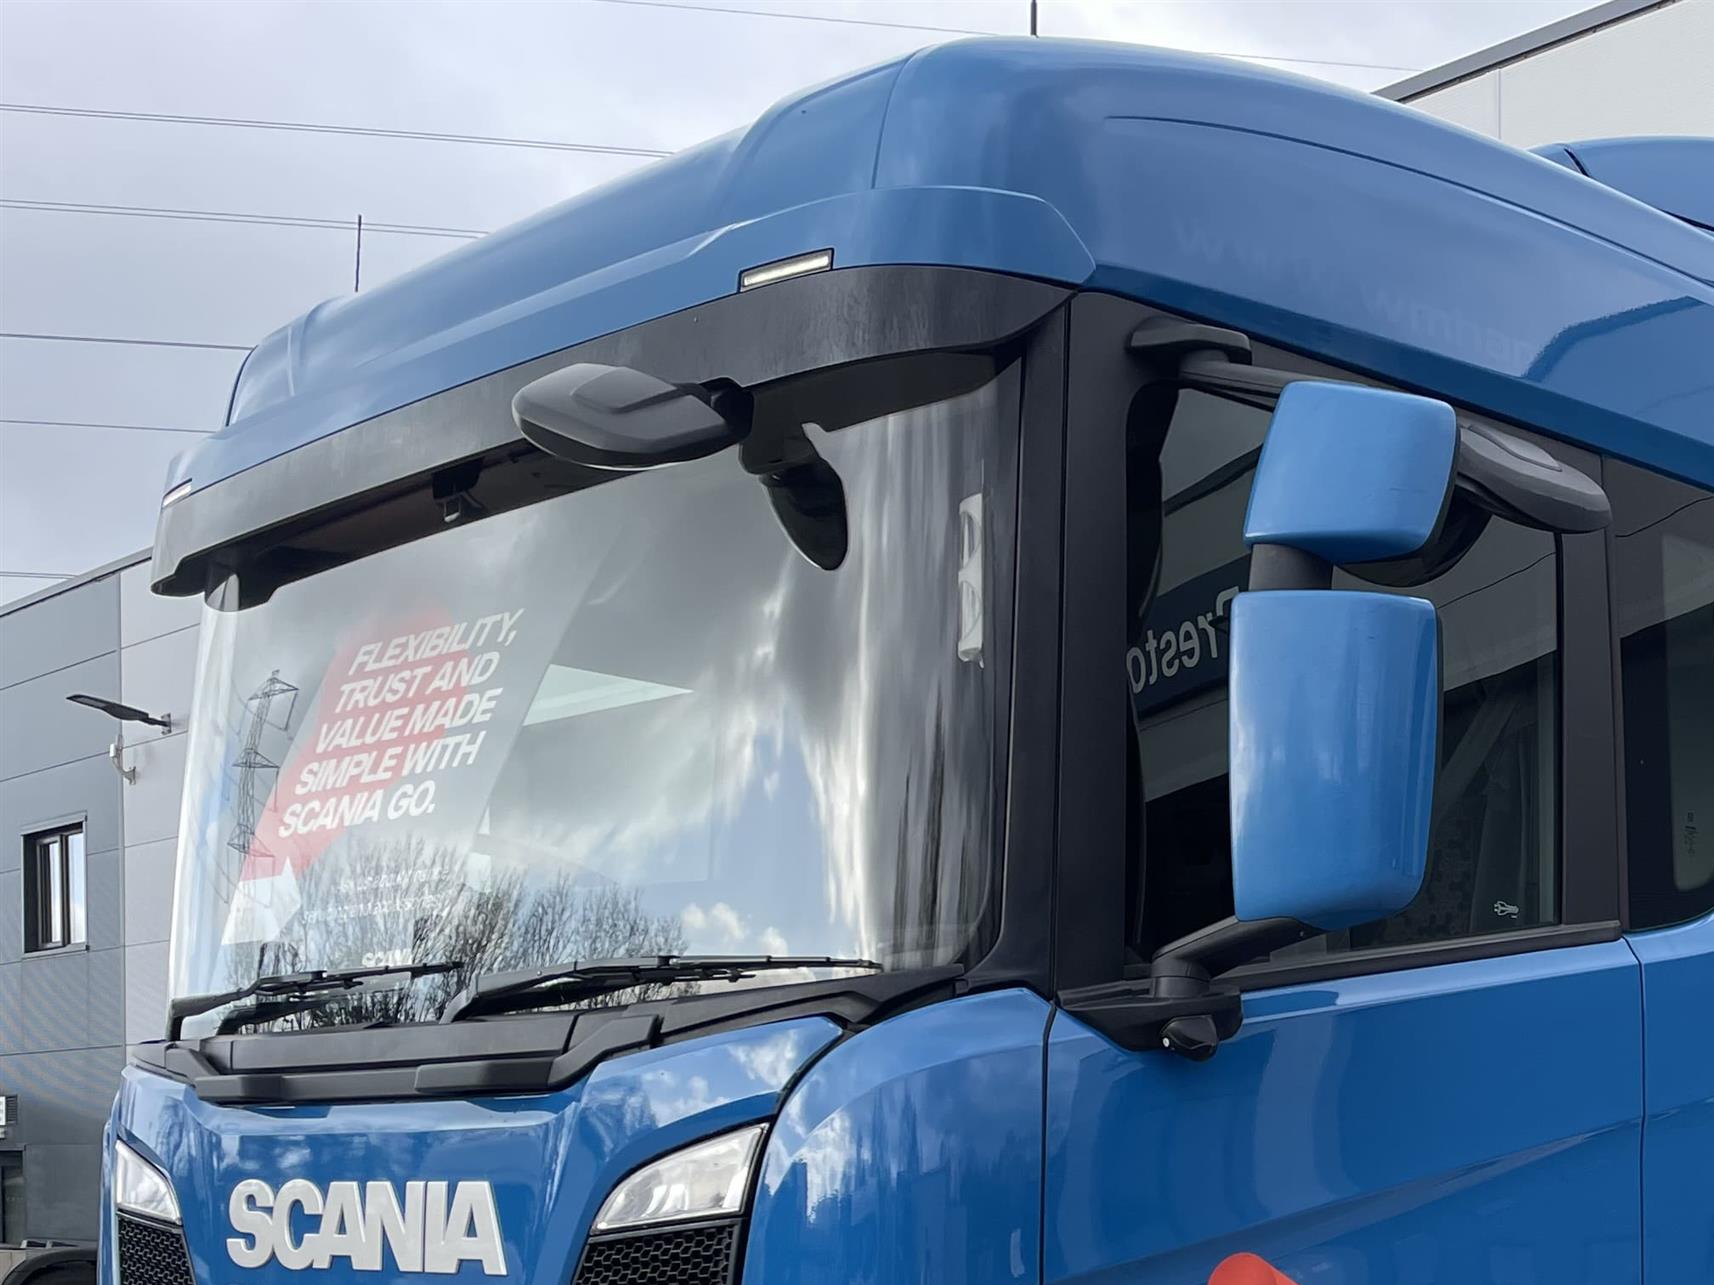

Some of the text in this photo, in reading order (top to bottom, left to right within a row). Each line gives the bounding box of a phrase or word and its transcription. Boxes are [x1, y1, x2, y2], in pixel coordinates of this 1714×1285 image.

[348, 608, 525, 676] FLEXIBILITY,
[335, 651, 501, 713] TRUST AND
[315, 687, 503, 754] VALUE MADE
[295, 730, 487, 796] SIMPLE WITH
[278, 780, 436, 838] SCANIA GO.
[226, 1178, 508, 1276] SCANIA
